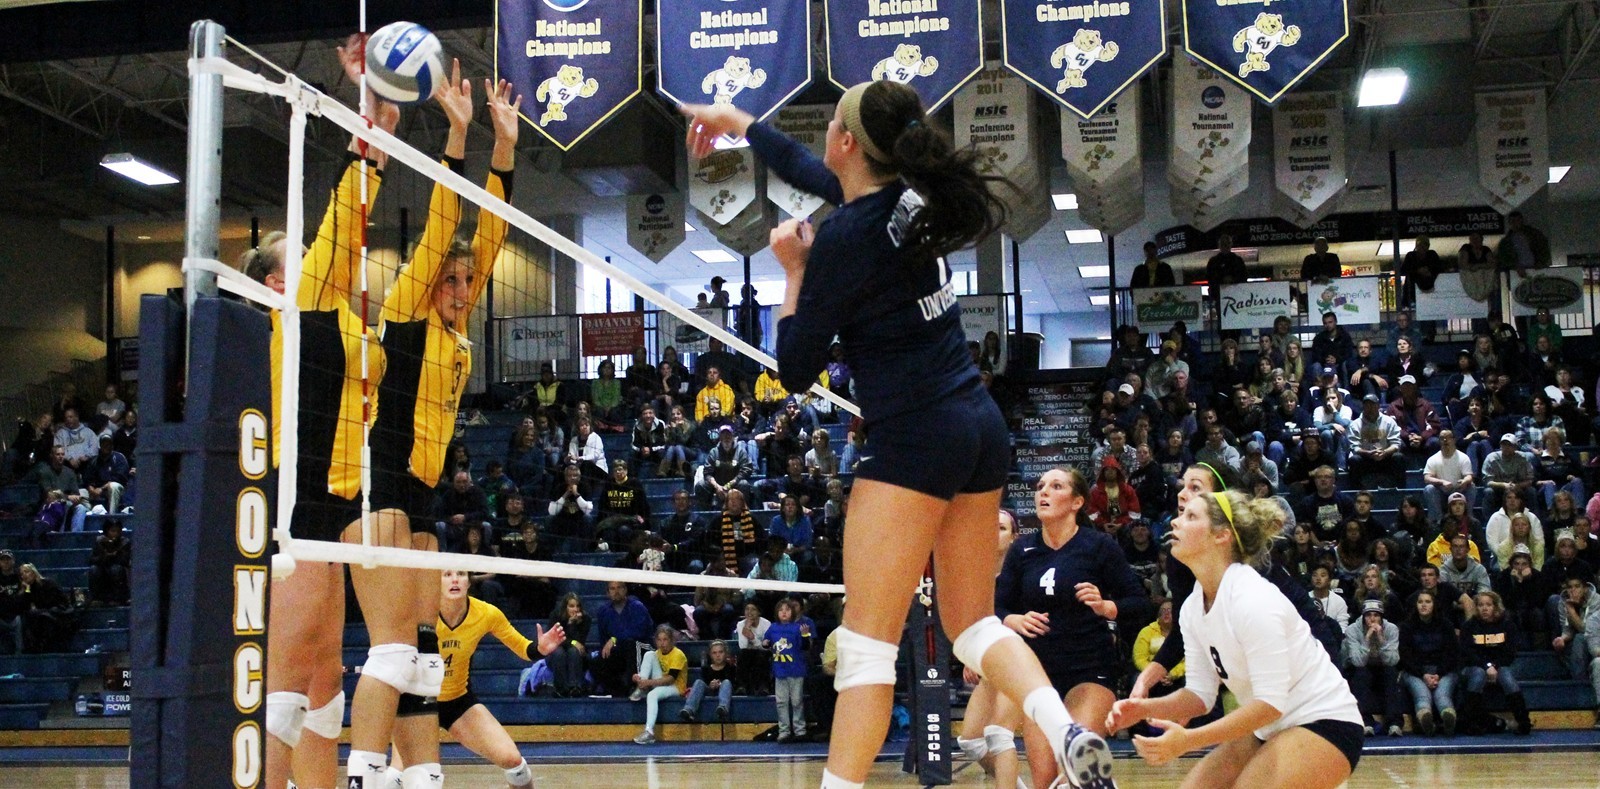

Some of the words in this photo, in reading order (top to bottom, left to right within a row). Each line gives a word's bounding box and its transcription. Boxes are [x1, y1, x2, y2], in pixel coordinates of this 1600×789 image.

[1036, 1, 1130, 22] Champions
[700, 8, 768, 29] National
[536, 18, 601, 37] National
[858, 16, 949, 37] Champions
[690, 28, 778, 50] Champions
[1256, 36, 1271, 50] CU
[526, 39, 611, 59] Champions
[1075, 53, 1089, 66] CU
[725, 79, 738, 92] CU
[558, 88, 570, 101] CU
[975, 105, 1008, 117] NSIC
[1199, 113, 1228, 121] National
[970, 123, 1015, 133] Conference
[1192, 122, 1234, 130] Tournament
[1080, 128, 1118, 136] Tournament
[1082, 136, 1116, 144] Champions
[1407, 216, 1435, 225] REAL
[1467, 213, 1499, 222] TASTE
[1249, 225, 1276, 234] REAL
[1408, 225, 1428, 233] AND
[1429, 224, 1452, 233] ZERO
[1454, 222, 1500, 231] CALORIES
[1165, 232, 1186, 243] TASTE
[1250, 233, 1269, 242] AND
[1270, 232, 1294, 241] ZERO
[1222, 292, 1288, 317] Radisson
[525, 328, 565, 340] Bremer
[1028, 387, 1049, 395] REAL
[1044, 393, 1061, 401] ZERO
[1024, 417, 1046, 425] REAL
[1063, 446, 1089, 454] TASTE
[1053, 454, 1090, 462] CALORIES
[607, 489, 634, 498] WAYNE
[1039, 567, 1056, 595] 4
[442, 640, 461, 650] WAYNE
[444, 653, 453, 668] 4
[1209, 646, 1228, 680] 9
[106, 694, 115, 702] ICE
[115, 694, 130, 702] COLD
